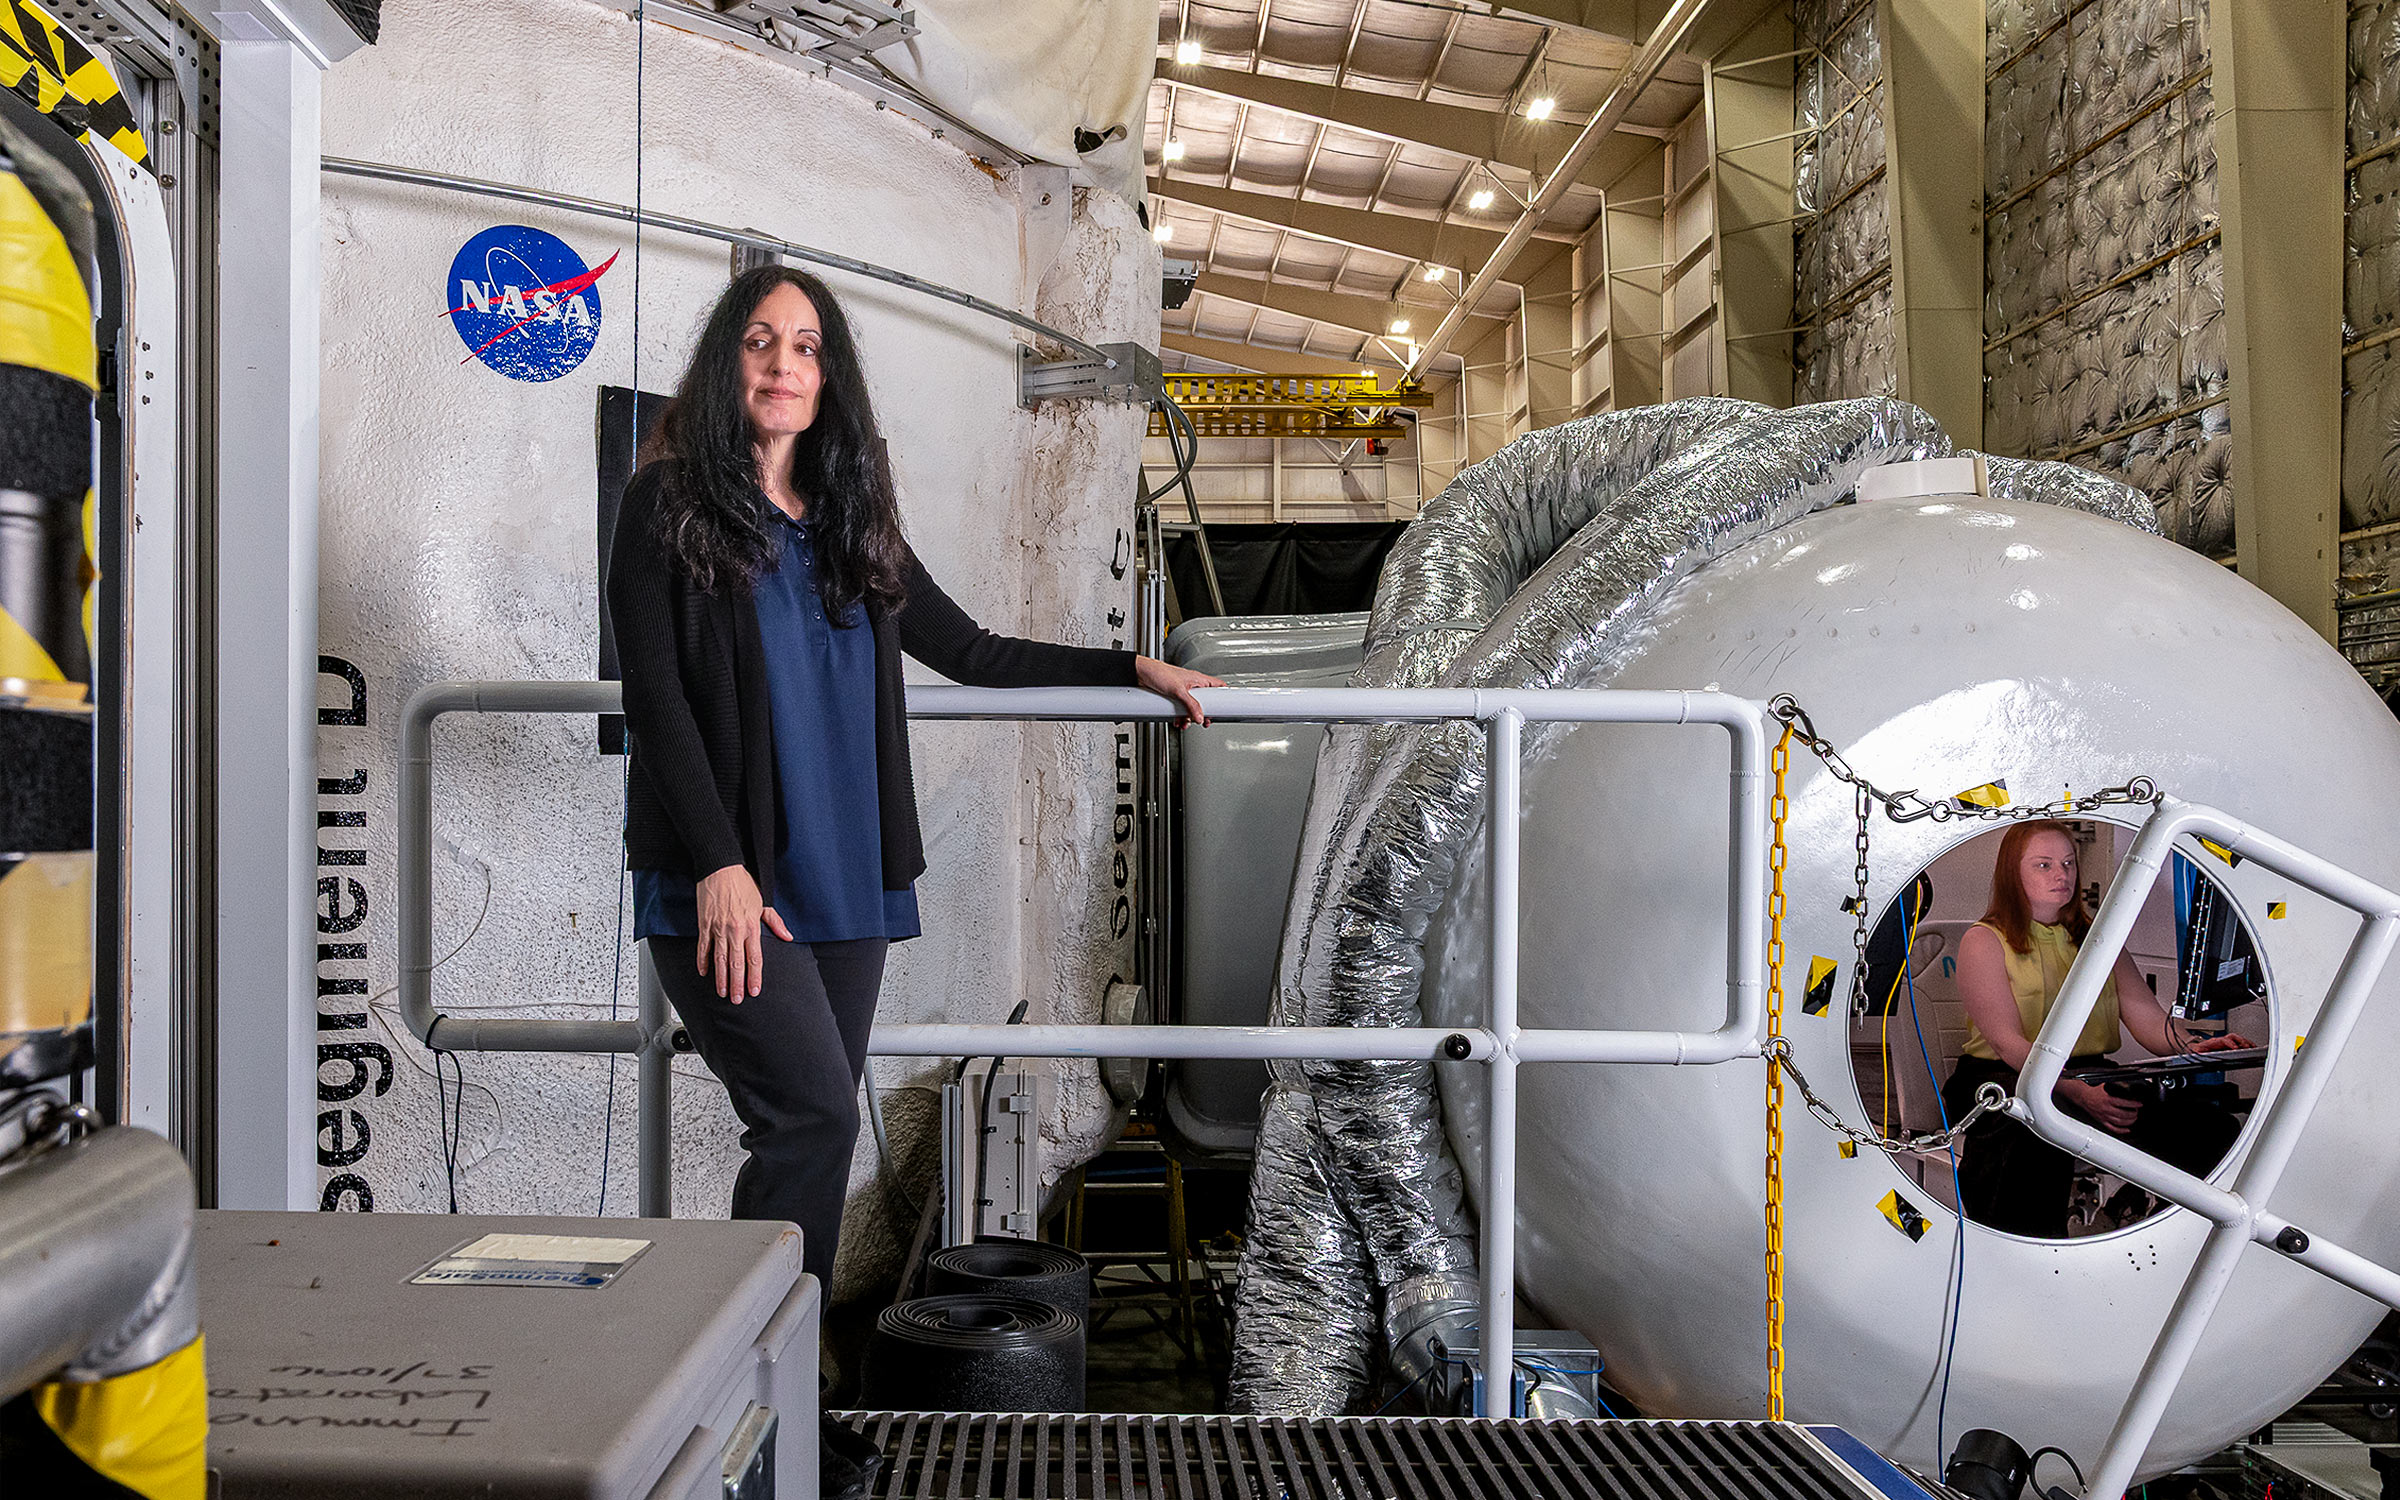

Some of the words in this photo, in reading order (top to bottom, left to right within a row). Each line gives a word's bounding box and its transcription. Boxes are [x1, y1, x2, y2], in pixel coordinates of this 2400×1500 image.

[460, 279, 592, 327] NASA
[1110, 528, 1130, 580] C
[1107, 607, 1134, 942] Segmt
